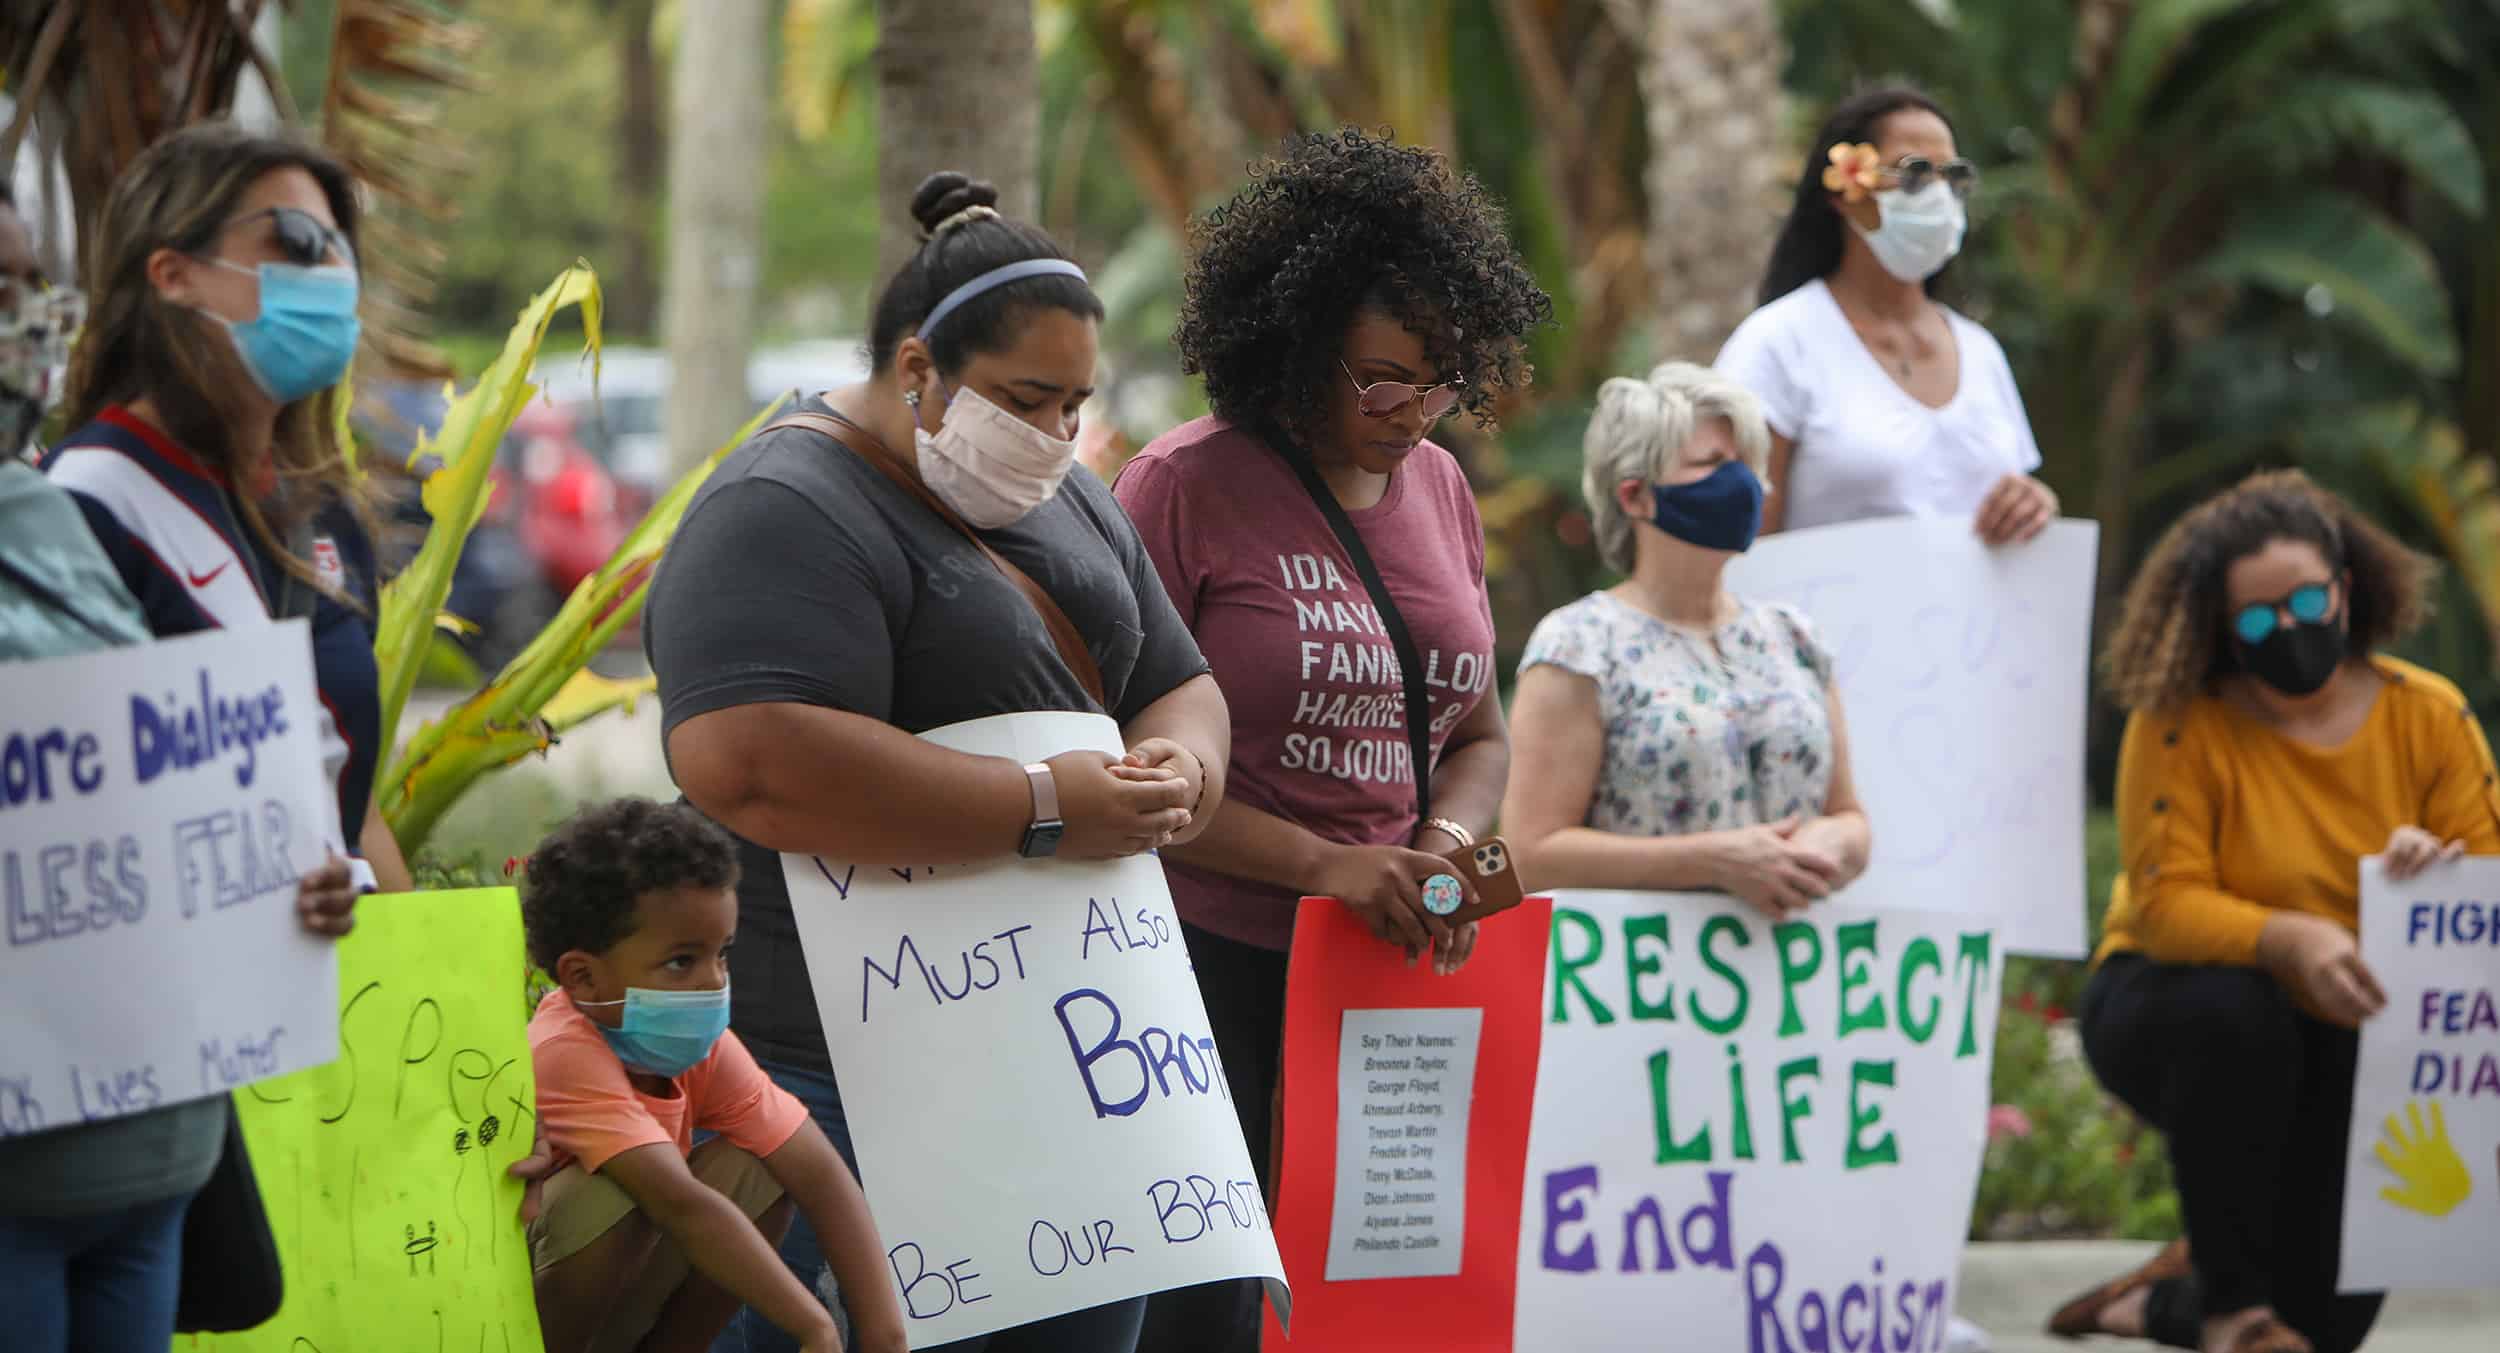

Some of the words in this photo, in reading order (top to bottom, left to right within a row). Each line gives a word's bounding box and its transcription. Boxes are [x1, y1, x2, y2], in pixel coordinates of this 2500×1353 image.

[1278, 554, 1347, 591] IDA
[1292, 692, 1437, 729] HARRIE
[1301, 641, 1403, 685] FANN
[1425, 649, 1492, 694] LOU
[1280, 734, 1415, 784] SOJOUR
[4, 834, 149, 947] LESS
[173, 798, 302, 919] FEAR
[1549, 907, 1993, 1059] RESPECT
[1054, 988, 1231, 1119] BROT
[888, 1241, 992, 1319] BE
[1028, 1219, 1134, 1276] OUR
[1145, 1174, 1264, 1244] BROT
[1540, 1165, 1736, 1274] End
